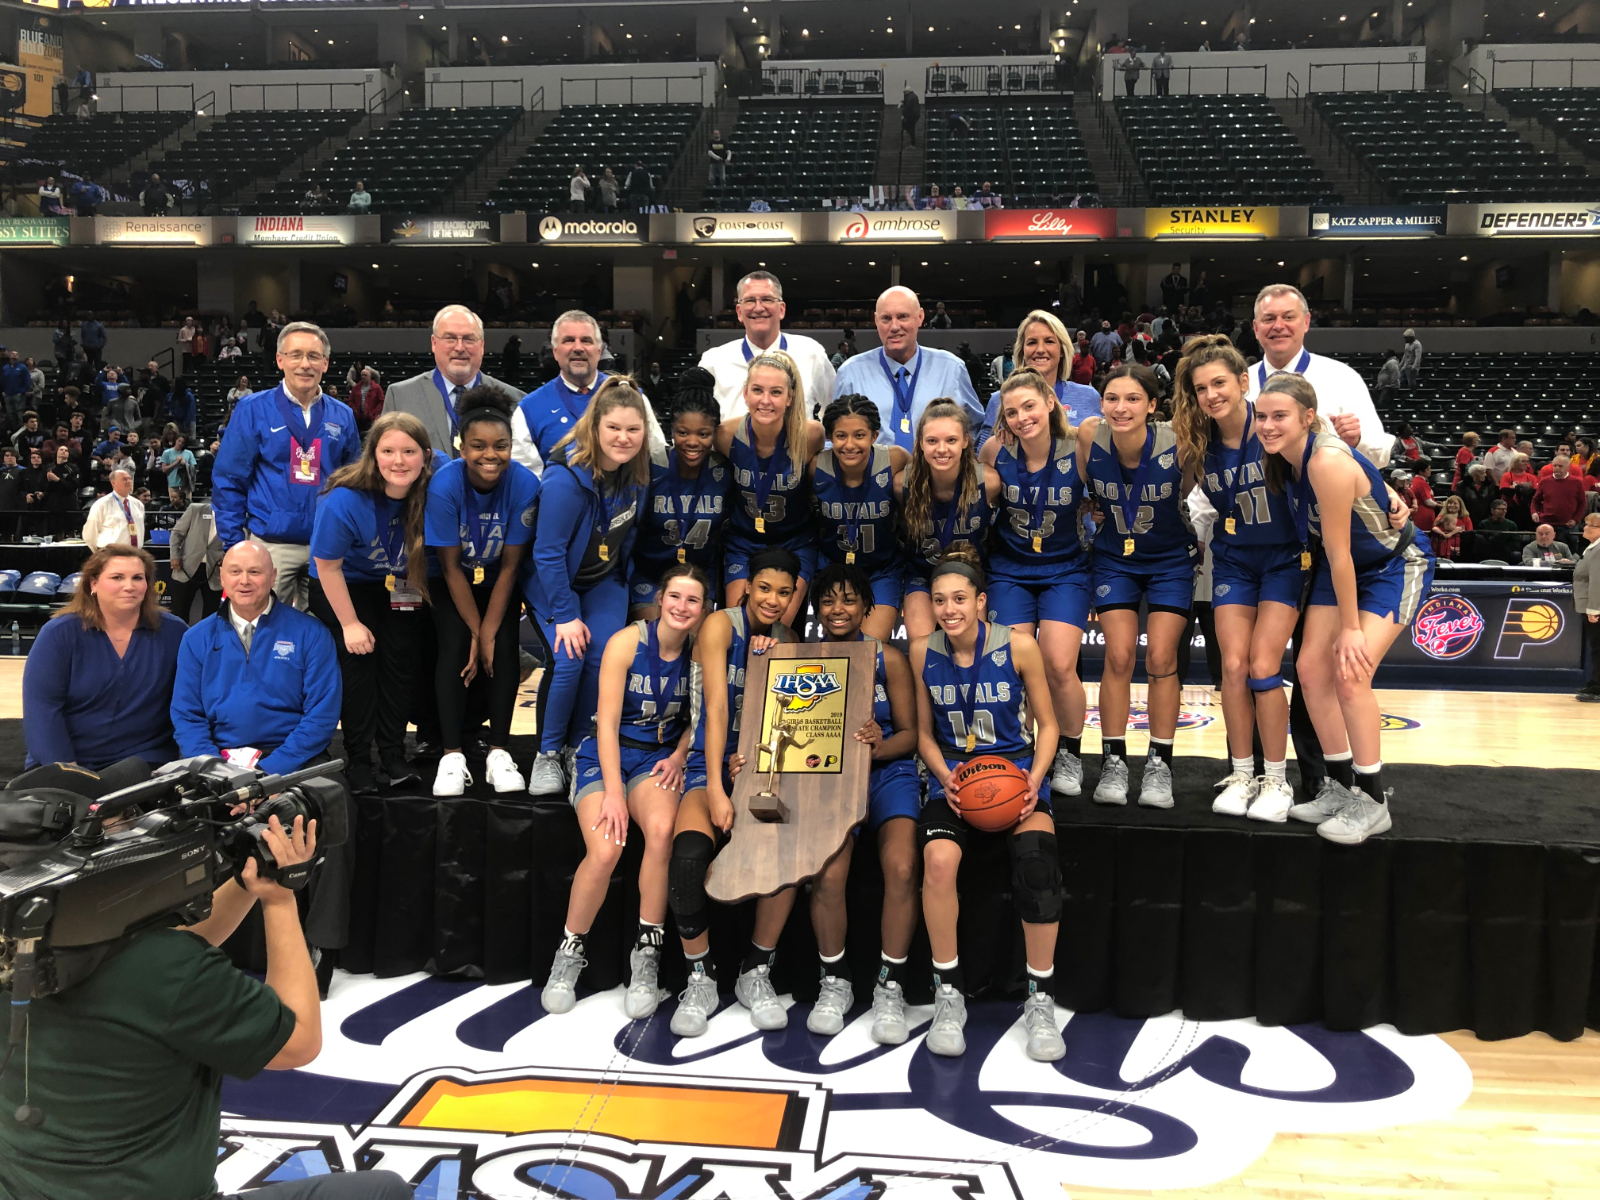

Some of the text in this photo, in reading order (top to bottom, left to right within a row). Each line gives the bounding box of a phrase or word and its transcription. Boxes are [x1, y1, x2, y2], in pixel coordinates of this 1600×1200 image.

[255, 216, 304, 231] INDIANA
[467, 220, 491, 229] CAPITAL
[872, 217, 940, 231] ambrose
[1028, 212, 1072, 235] Lilly
[1170, 209, 1254, 223] STANLEY
[1331, 217, 1356, 226] KATZ
[1358, 217, 1393, 226] SAPPER
[1405, 216, 1442, 225] MILLER
[1480, 212, 1589, 228] DEFENDERS
[22, 226, 70, 238] SUITES
[126, 221, 202, 233] Renaissance
[453, 229, 475, 238] WORLD
[564, 219, 637, 234] motorola
[719, 221, 746, 230] COAST
[756, 221, 784, 230] COAST
[1170, 225, 1206, 235] Security
[733, 462, 801, 491] ROLS
[1001, 485, 1072, 506] ROYLS
[741, 490, 786, 523] 33
[821, 499, 891, 520] ROYALS
[1235, 485, 1272, 525] 11
[1006, 506, 1057, 539] 23
[1110, 504, 1155, 535] 12
[661, 518, 712, 550] 34
[1424, 600, 1469, 616] INDIANA
[1415, 611, 1484, 645] Fever
[775, 674, 840, 696] IHSAA
[929, 681, 1011, 705] ROYALS
[947, 709, 997, 748] 10
[958, 761, 1008, 783] Wilson
[181, 844, 207, 860] SONY
